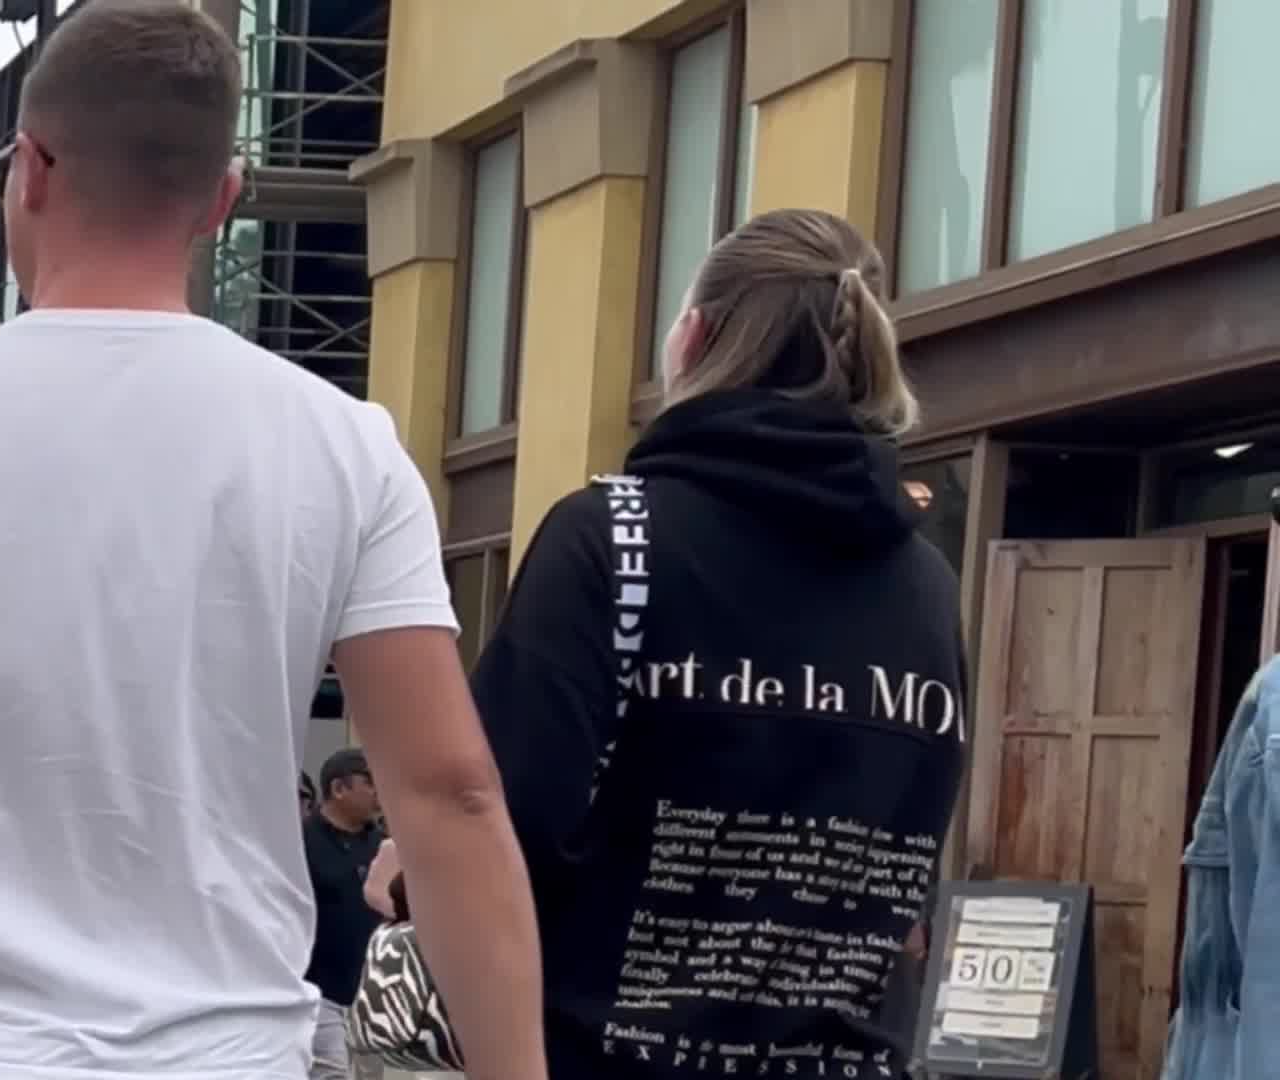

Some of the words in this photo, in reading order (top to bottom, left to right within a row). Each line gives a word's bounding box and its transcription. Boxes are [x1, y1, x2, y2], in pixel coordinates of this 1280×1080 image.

[720, 658, 785, 706] de
[803, 664, 846, 713] la
[867, 665, 966, 742] MO
[656, 800, 726, 826] Everyday
[781, 813, 795, 826] is
[904, 834, 937, 850] with
[809, 833, 827, 848] in
[688, 843, 705, 857] in
[744, 847, 765, 860] of
[767, 852, 785, 862] us
[789, 851, 820, 865] and
[896, 868, 917, 881] of
[724, 879, 759, 900] they
[775, 866, 802, 881] has
[868, 885, 902, 899] with
[632, 909, 656, 925] It's
[710, 921, 754, 936] argue
[846, 932, 863, 945] in
[627, 925, 655, 942] but
[663, 935, 689, 947] not
[698, 936, 742, 949] about
[750, 937, 776, 952] the
[826, 947, 883, 965] fashion
[624, 948, 680, 966] symbol
[687, 952, 717, 966] and
[740, 956, 768, 973] way
[818, 965, 835, 977] in
[958, 954, 1027, 984] 50
[706, 988, 738, 1002] and
[603, 1021, 666, 1045] Fashion
[677, 1033, 692, 1050] is
